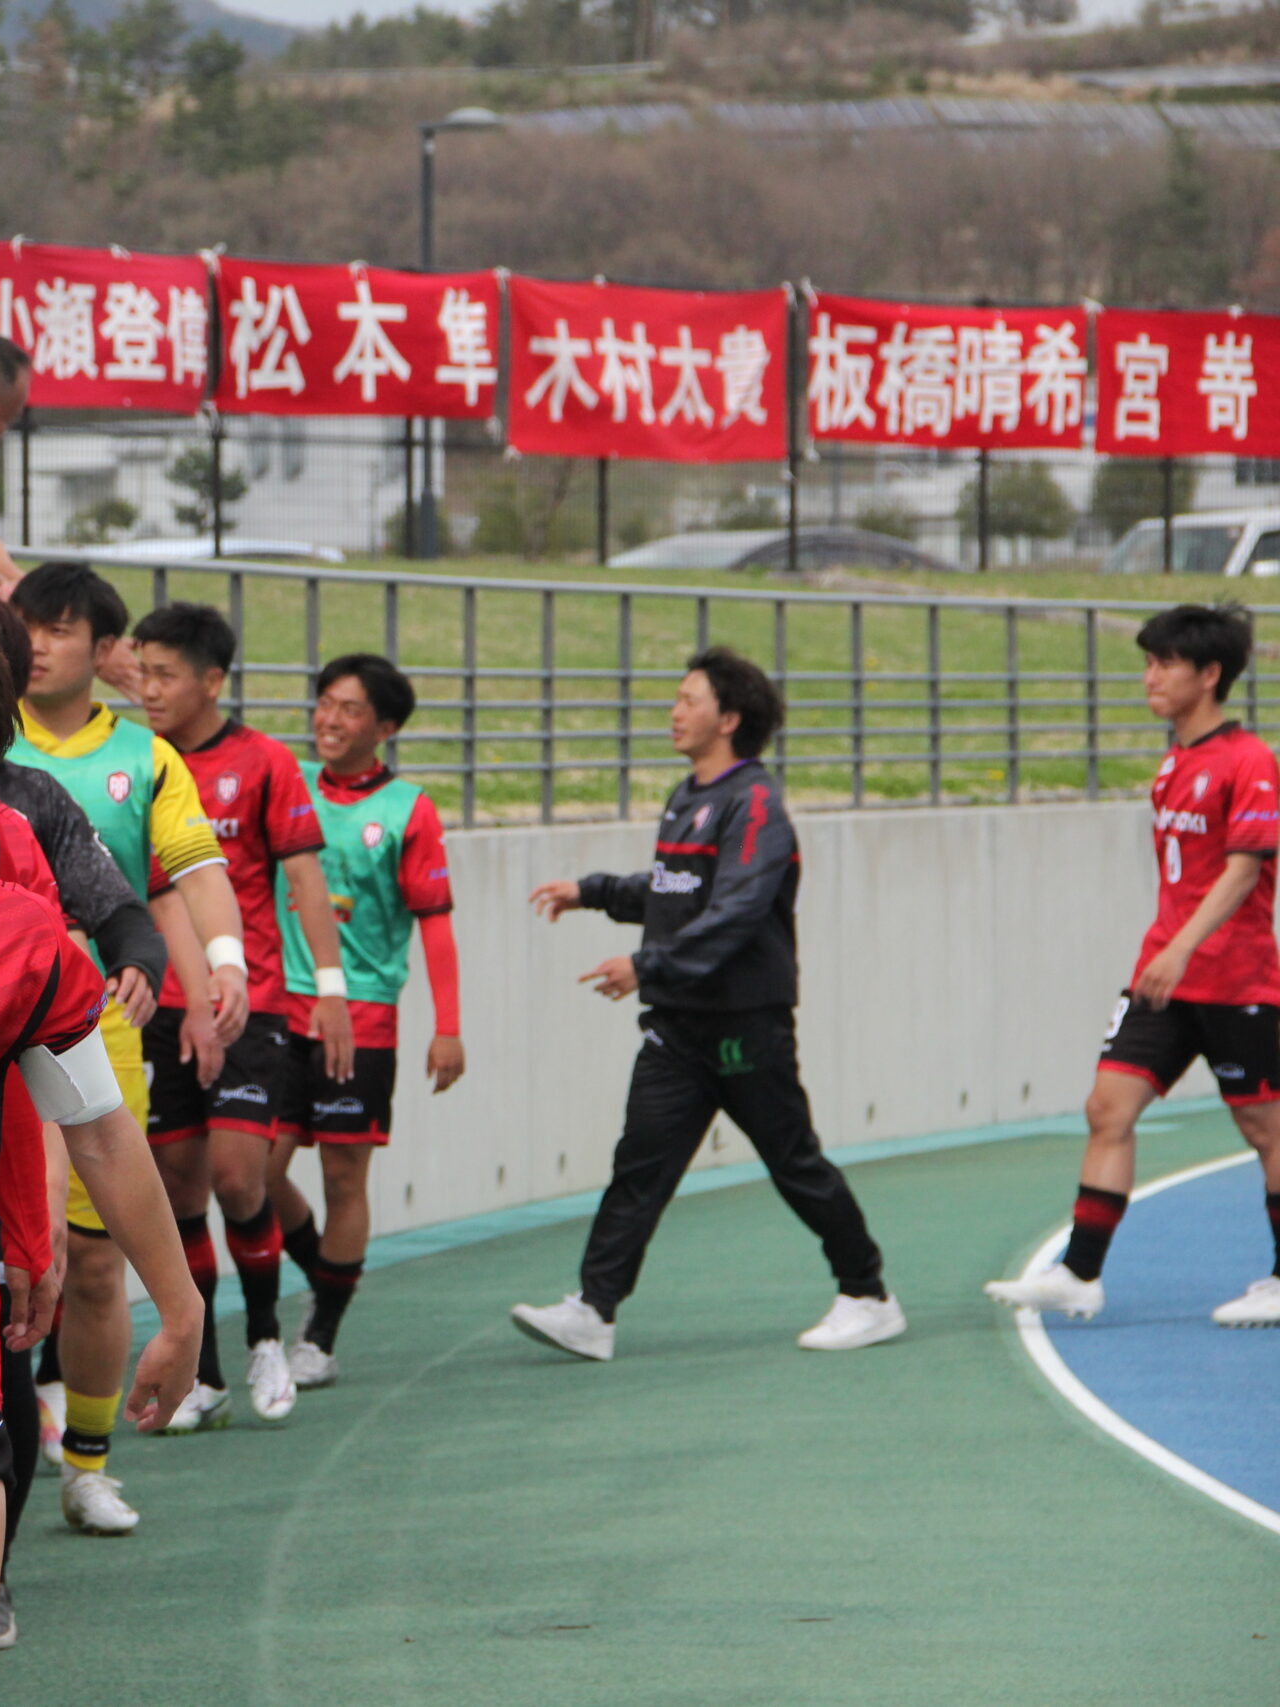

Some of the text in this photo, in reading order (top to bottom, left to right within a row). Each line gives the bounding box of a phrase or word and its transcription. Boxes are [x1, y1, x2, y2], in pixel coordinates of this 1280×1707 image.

[229, 276, 498, 406] 松本隼
[524, 317, 771, 429] 木村太貴
[808, 313, 1088, 437] 板橋晴希
